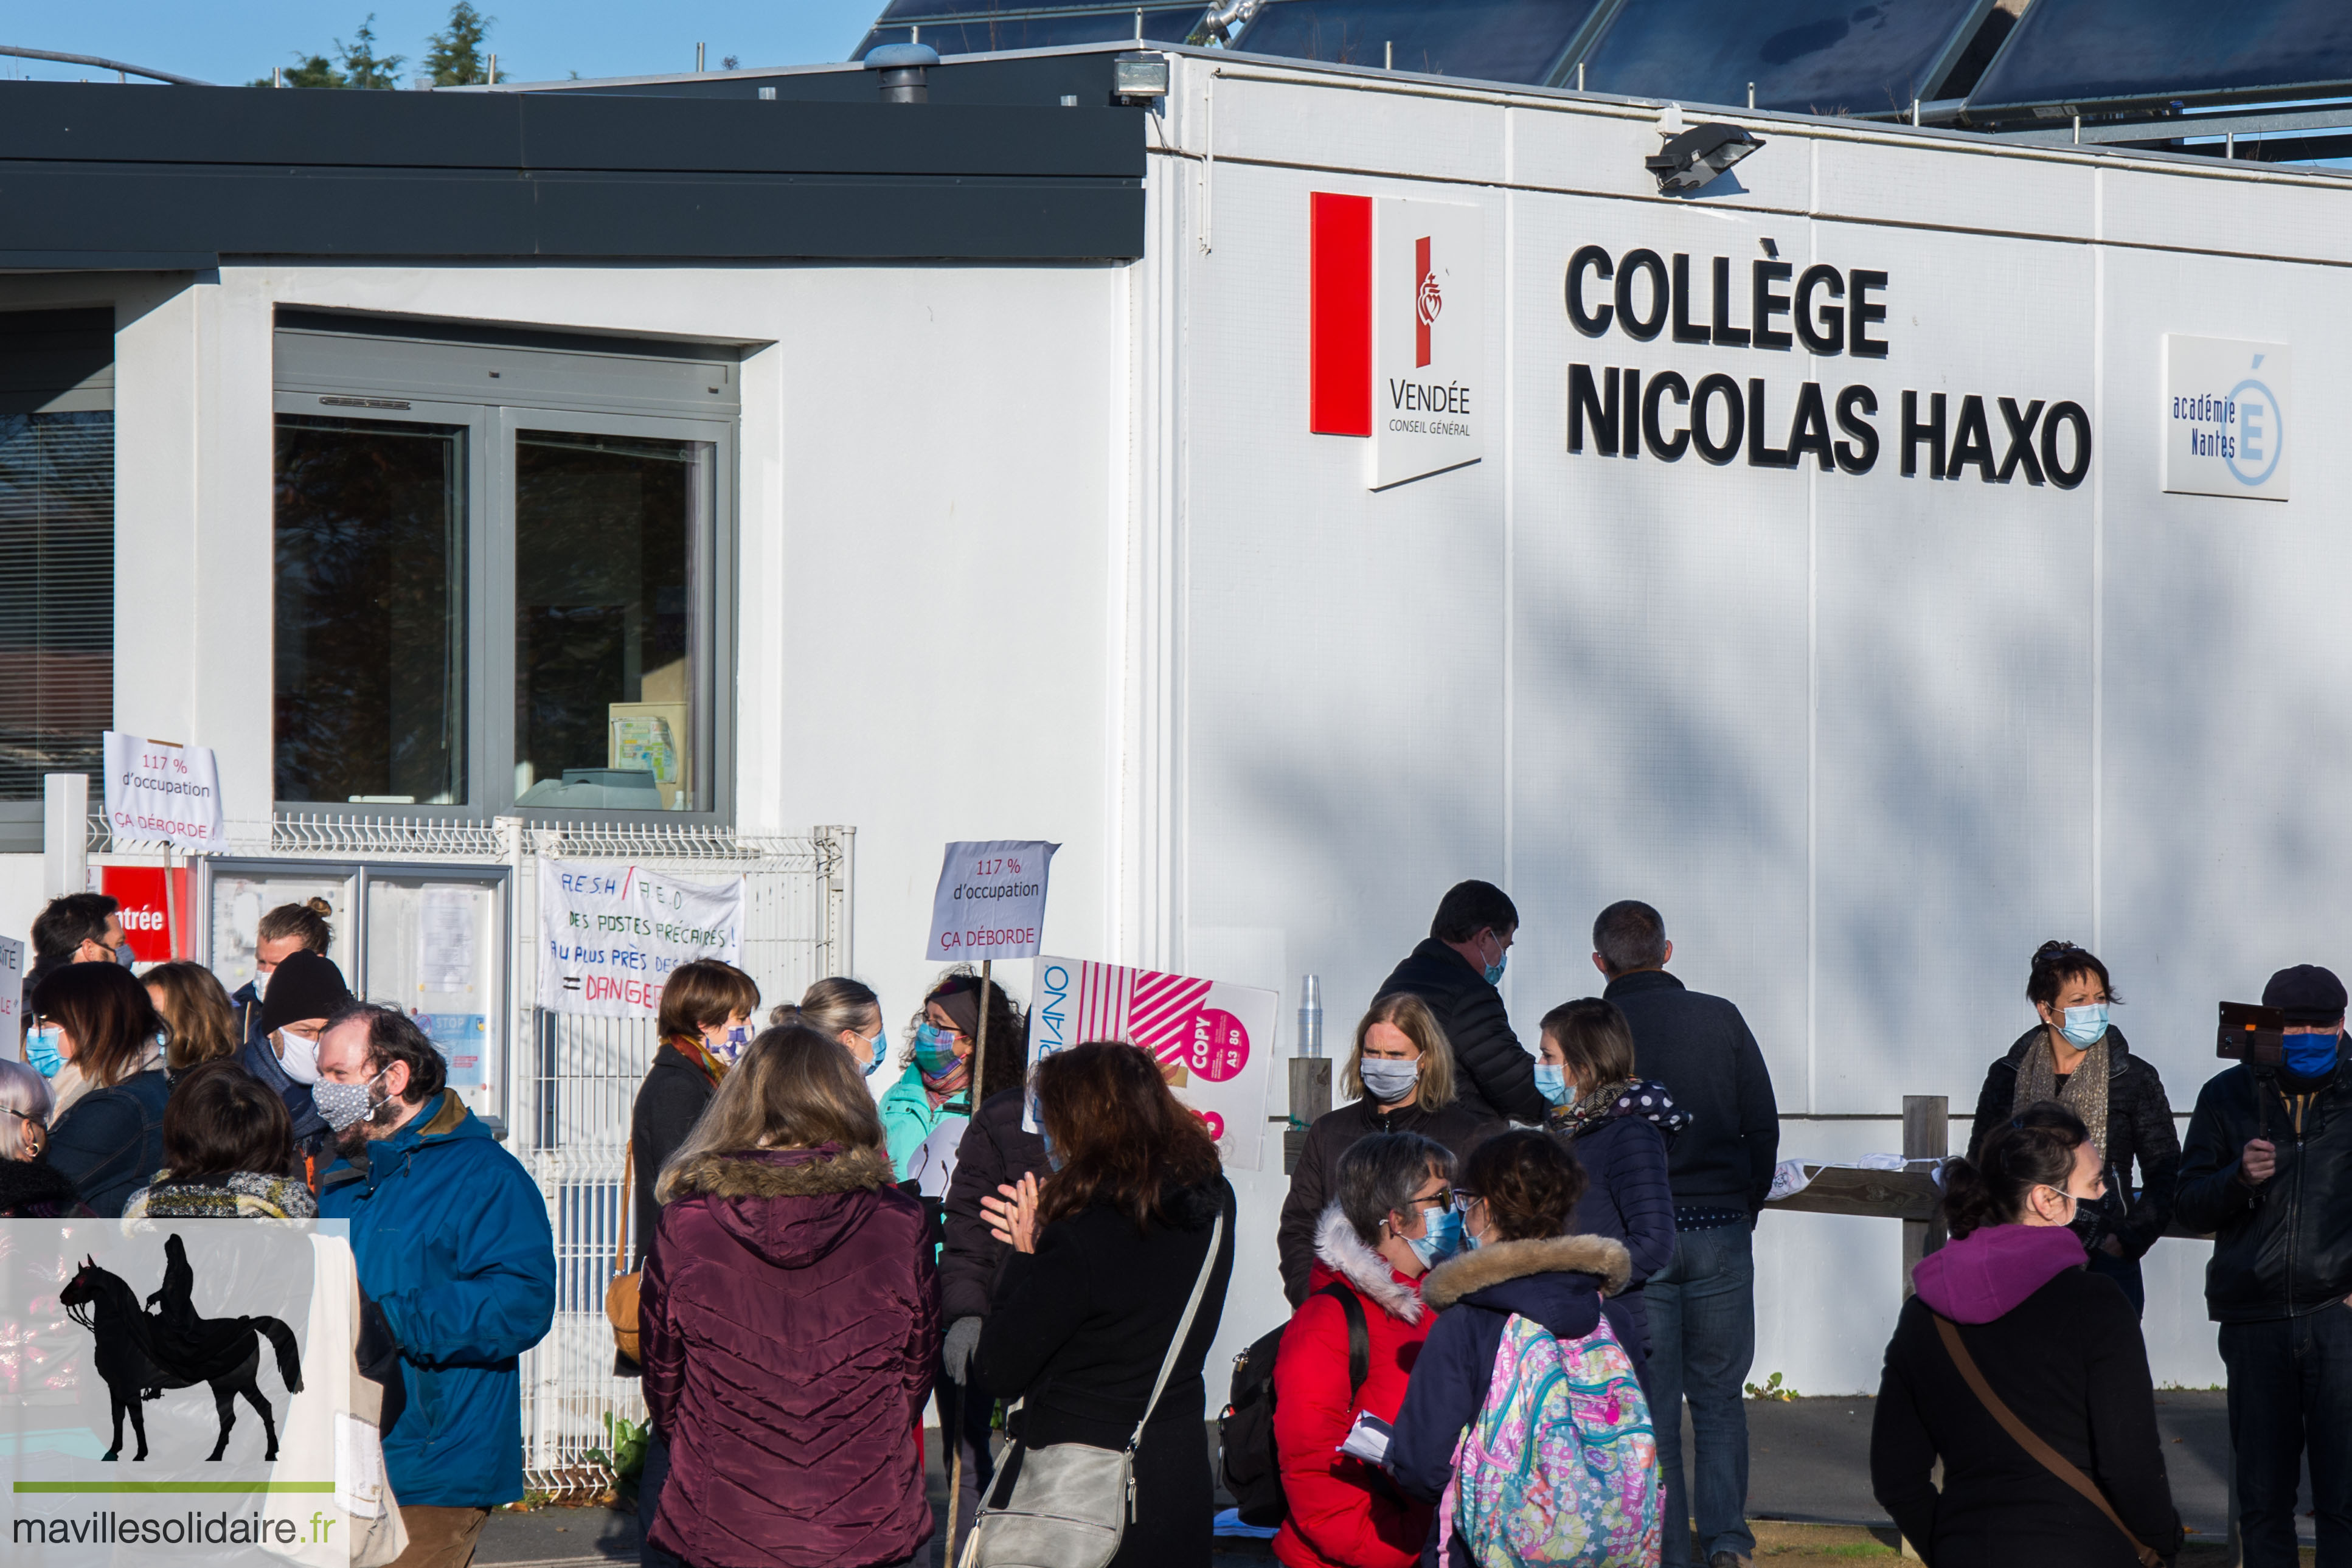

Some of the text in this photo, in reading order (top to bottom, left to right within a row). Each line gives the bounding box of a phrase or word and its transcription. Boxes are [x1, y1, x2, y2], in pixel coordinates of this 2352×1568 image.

[1565, 237, 1889, 357] COLLÈGE
[2173, 393, 2235, 424] académie
[1389, 419, 1470, 437] CONSEIL GÉNÉRAL
[1567, 364, 2092, 489] NICOLAS HAXO
[2191, 428, 2235, 459] Nantes
[143, 754, 187, 774] 117 %
[122, 771, 210, 797] d'occupation
[114, 812, 134, 828] ÇA
[137, 813, 207, 839] DÉBORDE
[976, 858, 1021, 875] 117 %
[954, 882, 1039, 901] d'occupation
[115, 904, 163, 930] ntrée
[570, 911, 589, 929] DES
[598, 915, 651, 935] POSTES
[941, 925, 1035, 951] ÇA DÉBORDE
[551, 940, 569, 960] AU
[575, 946, 605, 963] PLUS
[612, 943, 647, 971] PRÈS
[436, 1017, 465, 1029] STOP
[1033, 965, 1069, 1122] RIANO
[1192, 1016, 1211, 1069] COPY
[1226, 1029, 1240, 1068] A3 80
